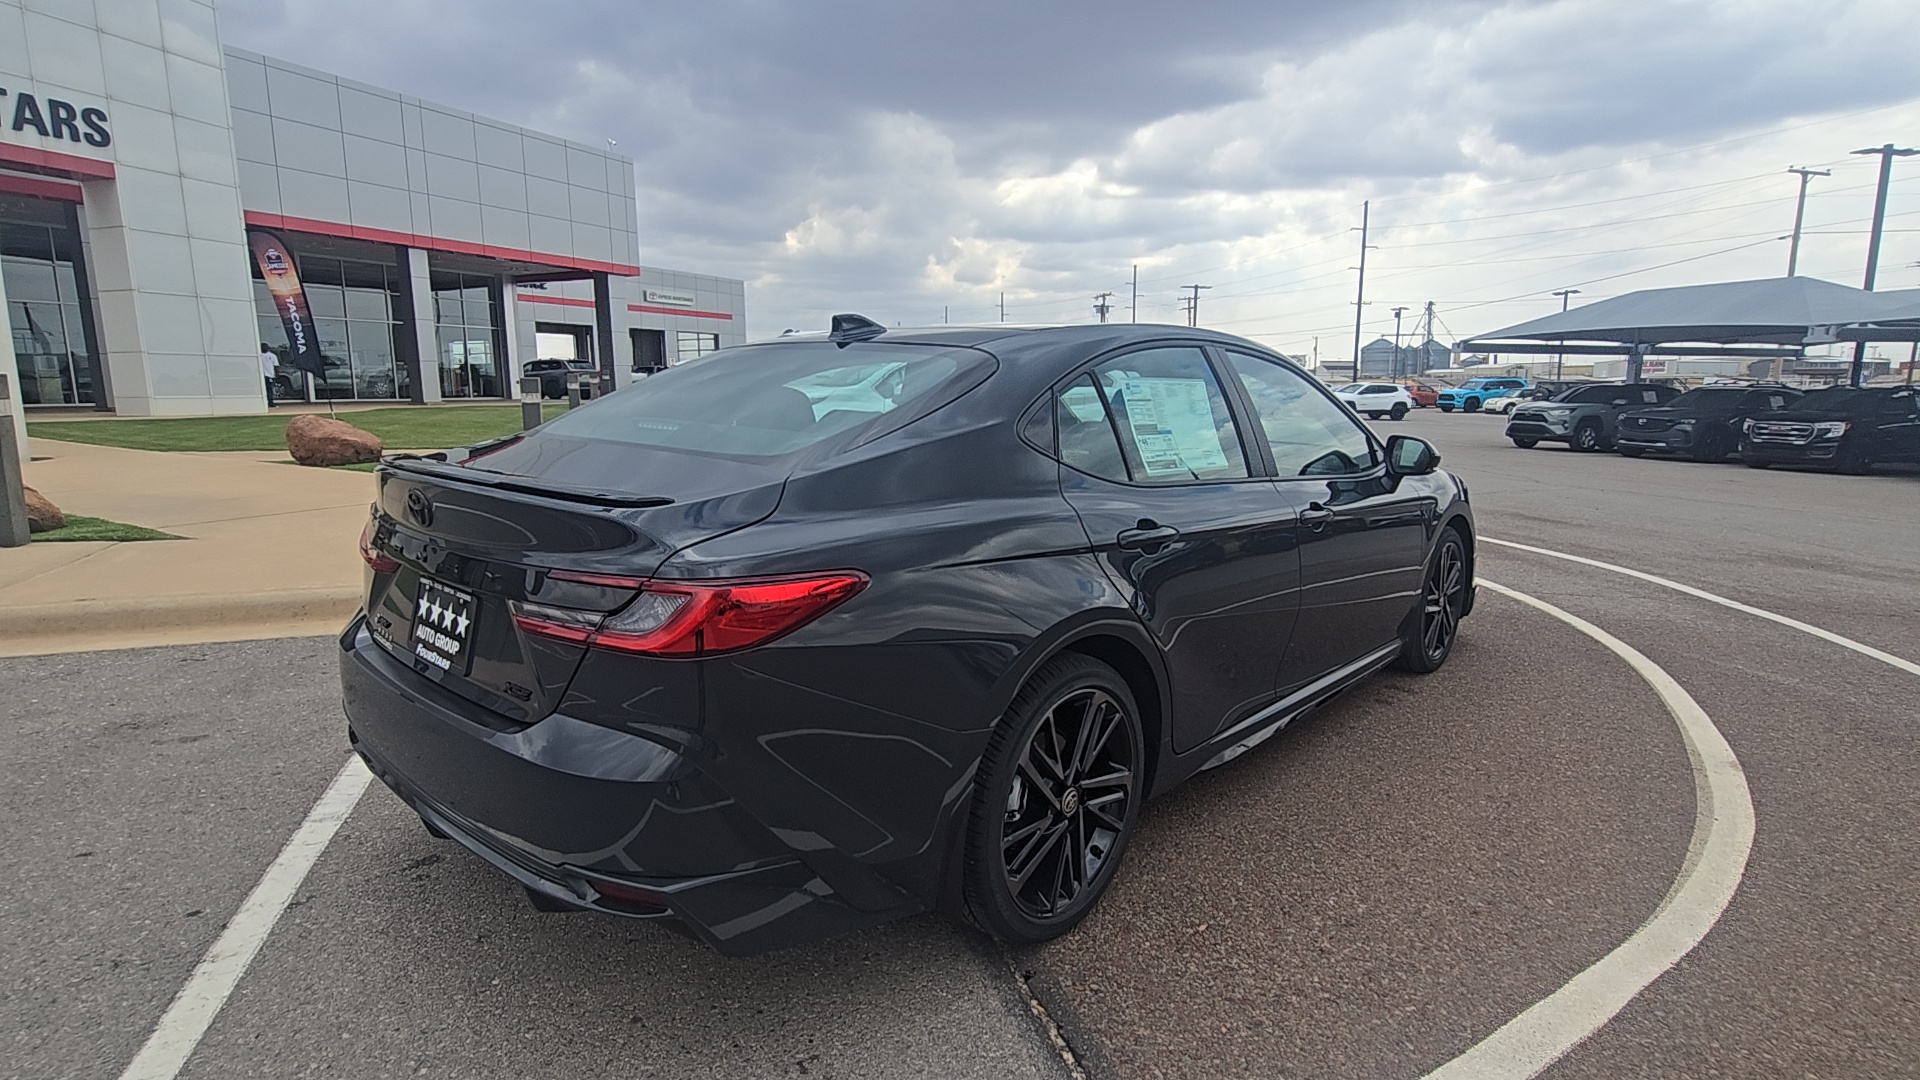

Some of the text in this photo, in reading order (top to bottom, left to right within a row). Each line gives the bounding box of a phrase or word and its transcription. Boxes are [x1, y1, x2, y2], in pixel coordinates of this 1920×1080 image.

[285, 296, 307, 355] TACOMA
[416, 623, 436, 644] AUTO
[434, 632, 461, 655] GROUP
